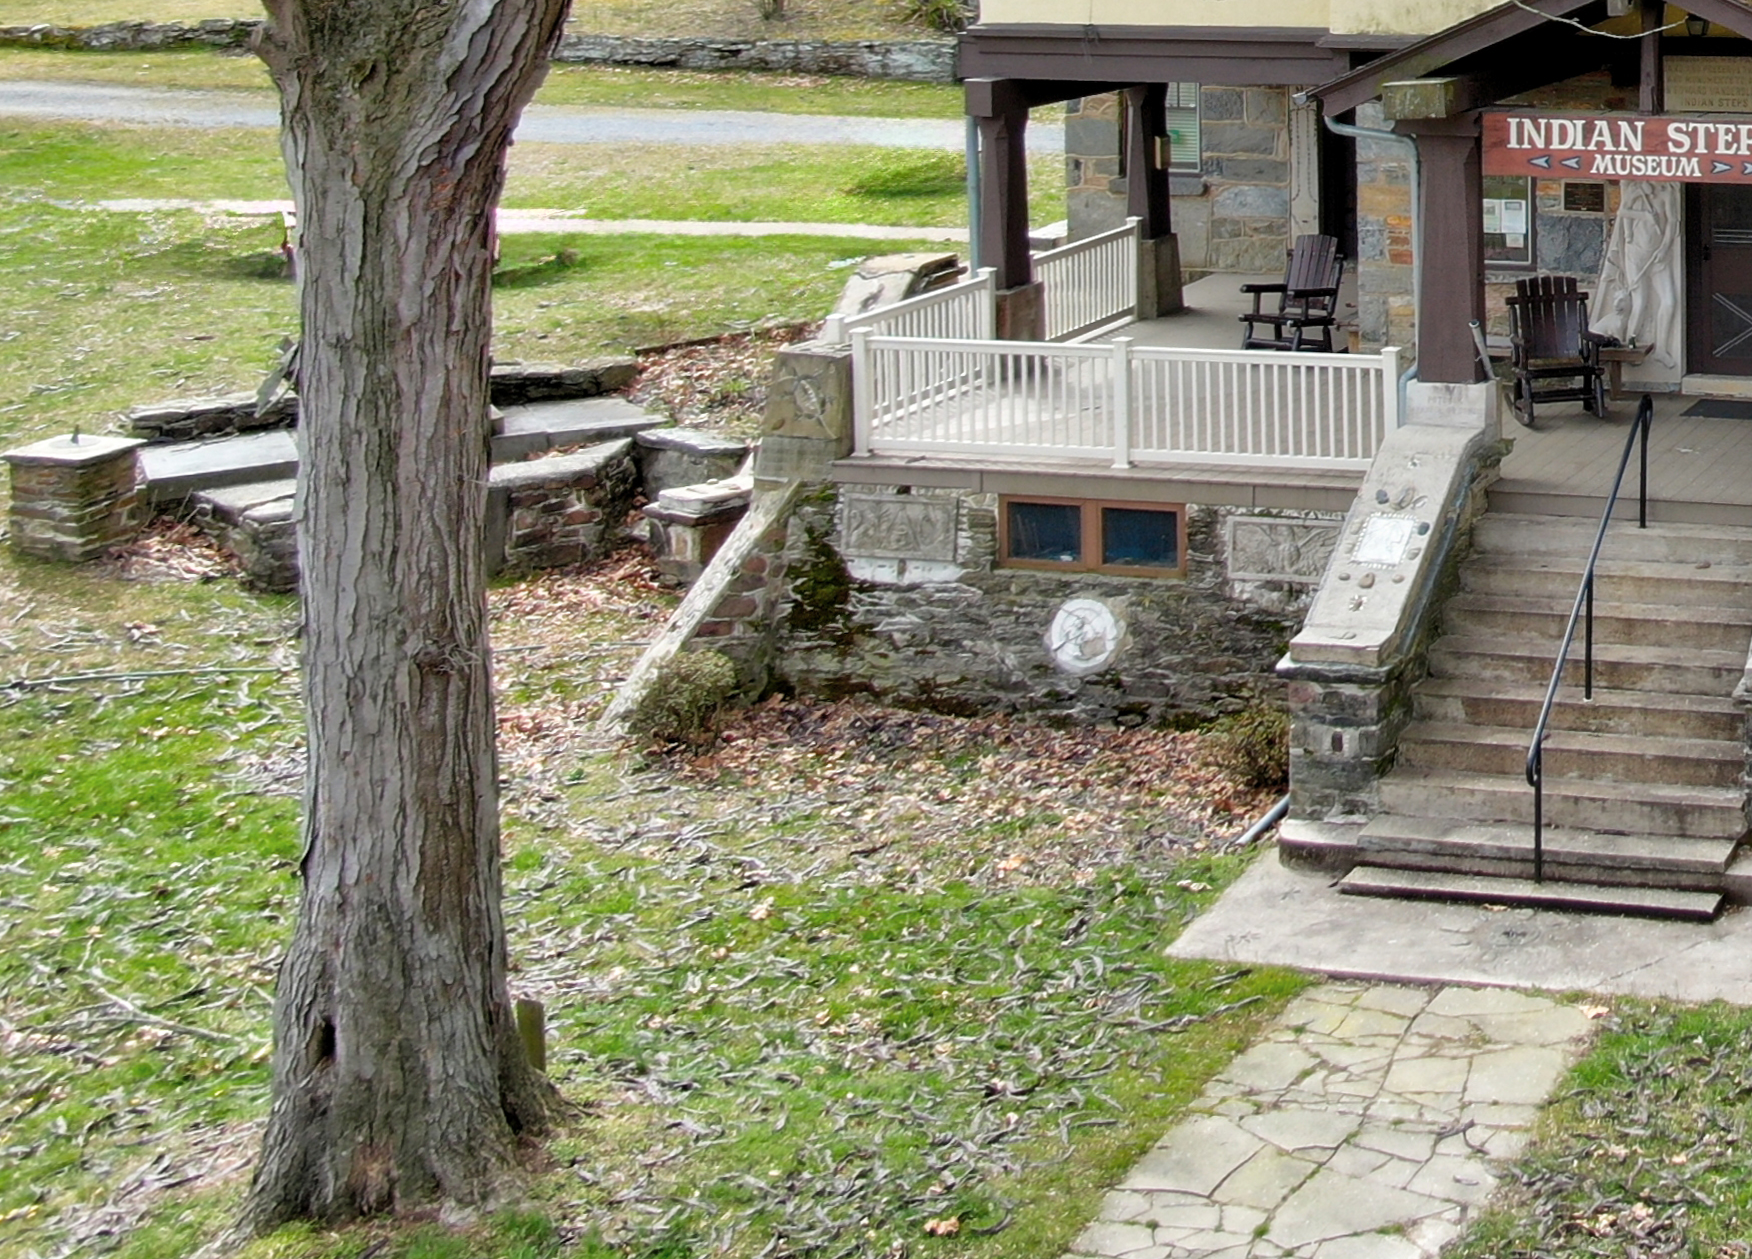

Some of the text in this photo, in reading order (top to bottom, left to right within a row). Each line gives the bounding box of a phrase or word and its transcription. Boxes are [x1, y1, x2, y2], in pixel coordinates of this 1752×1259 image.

[1681, 97, 1714, 107] INDIAN
[1718, 97, 1749, 108] STEPS
[1506, 117, 1645, 152] INDIAN
[1589, 154, 1702, 177] MUSEUM
